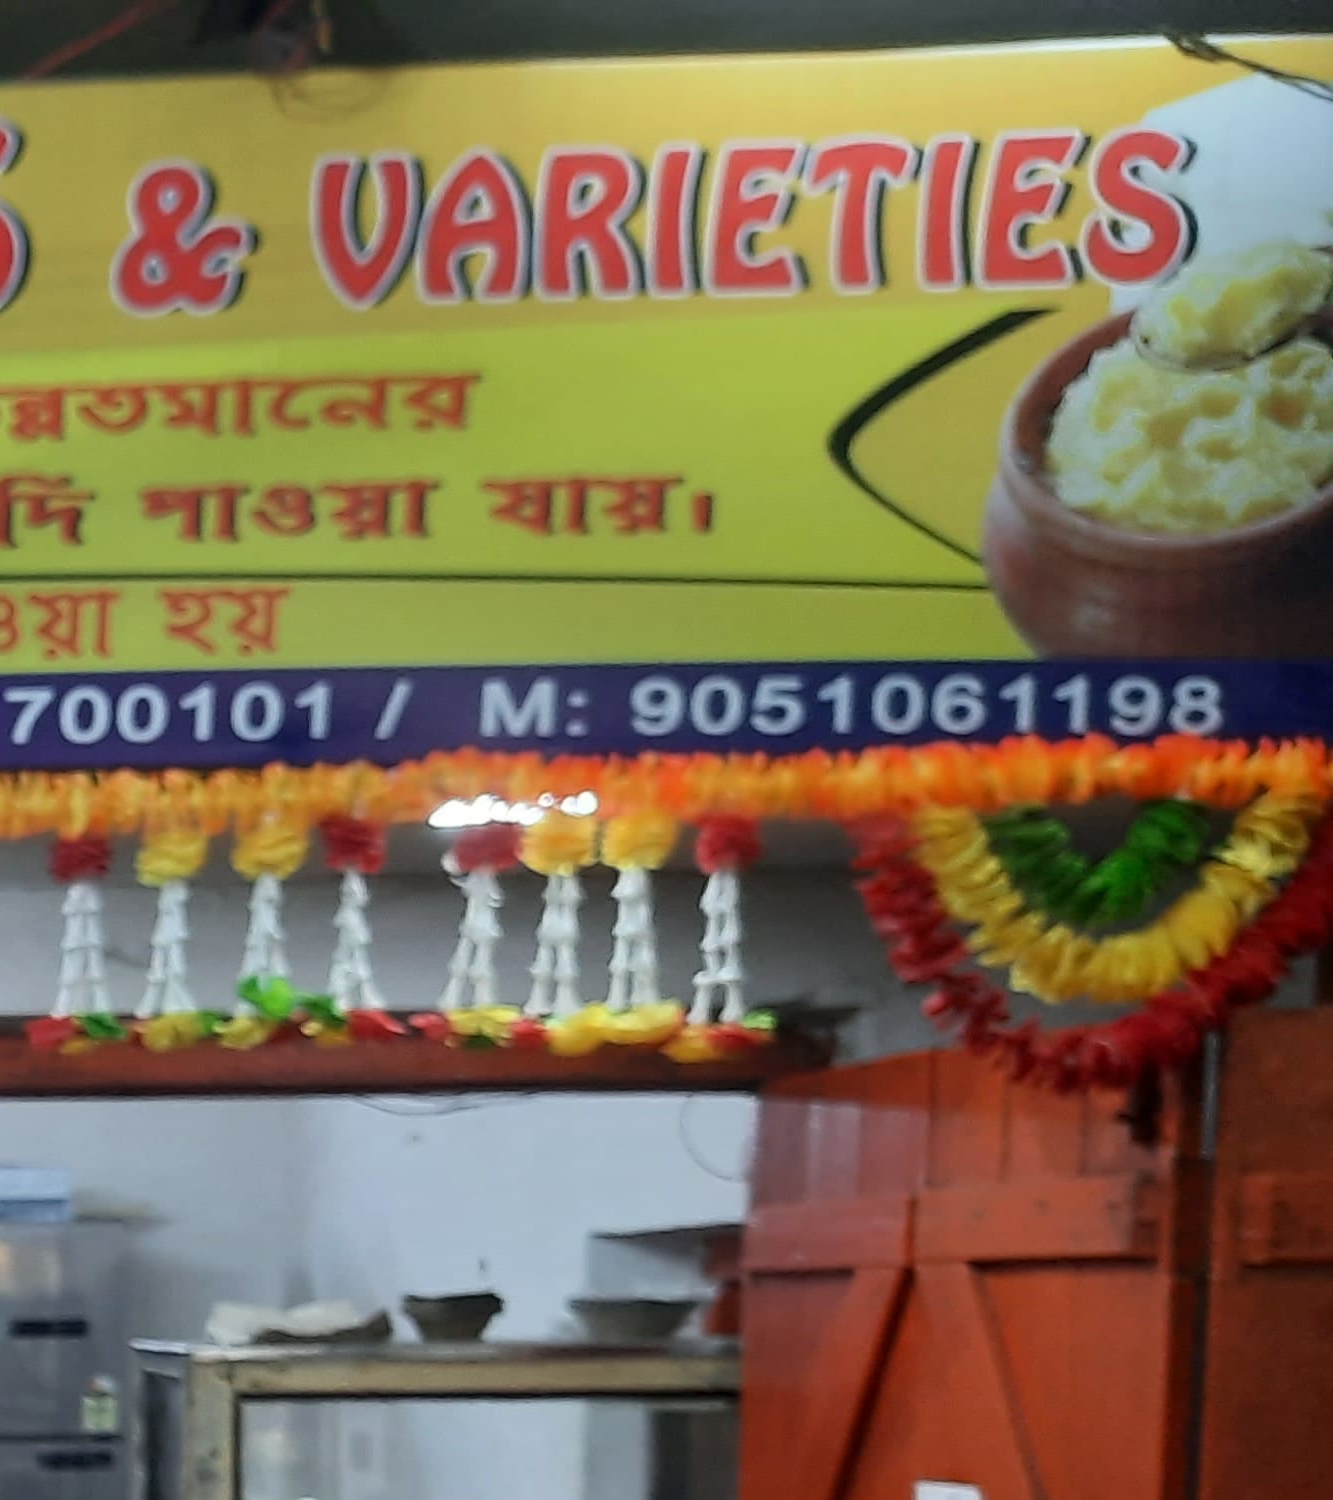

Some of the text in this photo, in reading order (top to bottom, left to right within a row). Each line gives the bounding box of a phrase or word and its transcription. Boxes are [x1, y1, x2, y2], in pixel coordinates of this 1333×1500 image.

[110, 158, 253, 316] &
[310, 127, 1199, 311] VARIETIES
[1, 684, 331, 744] 700101
[478, 680, 590, 738] M:
[628, 674, 1224, 738] 9051061198
